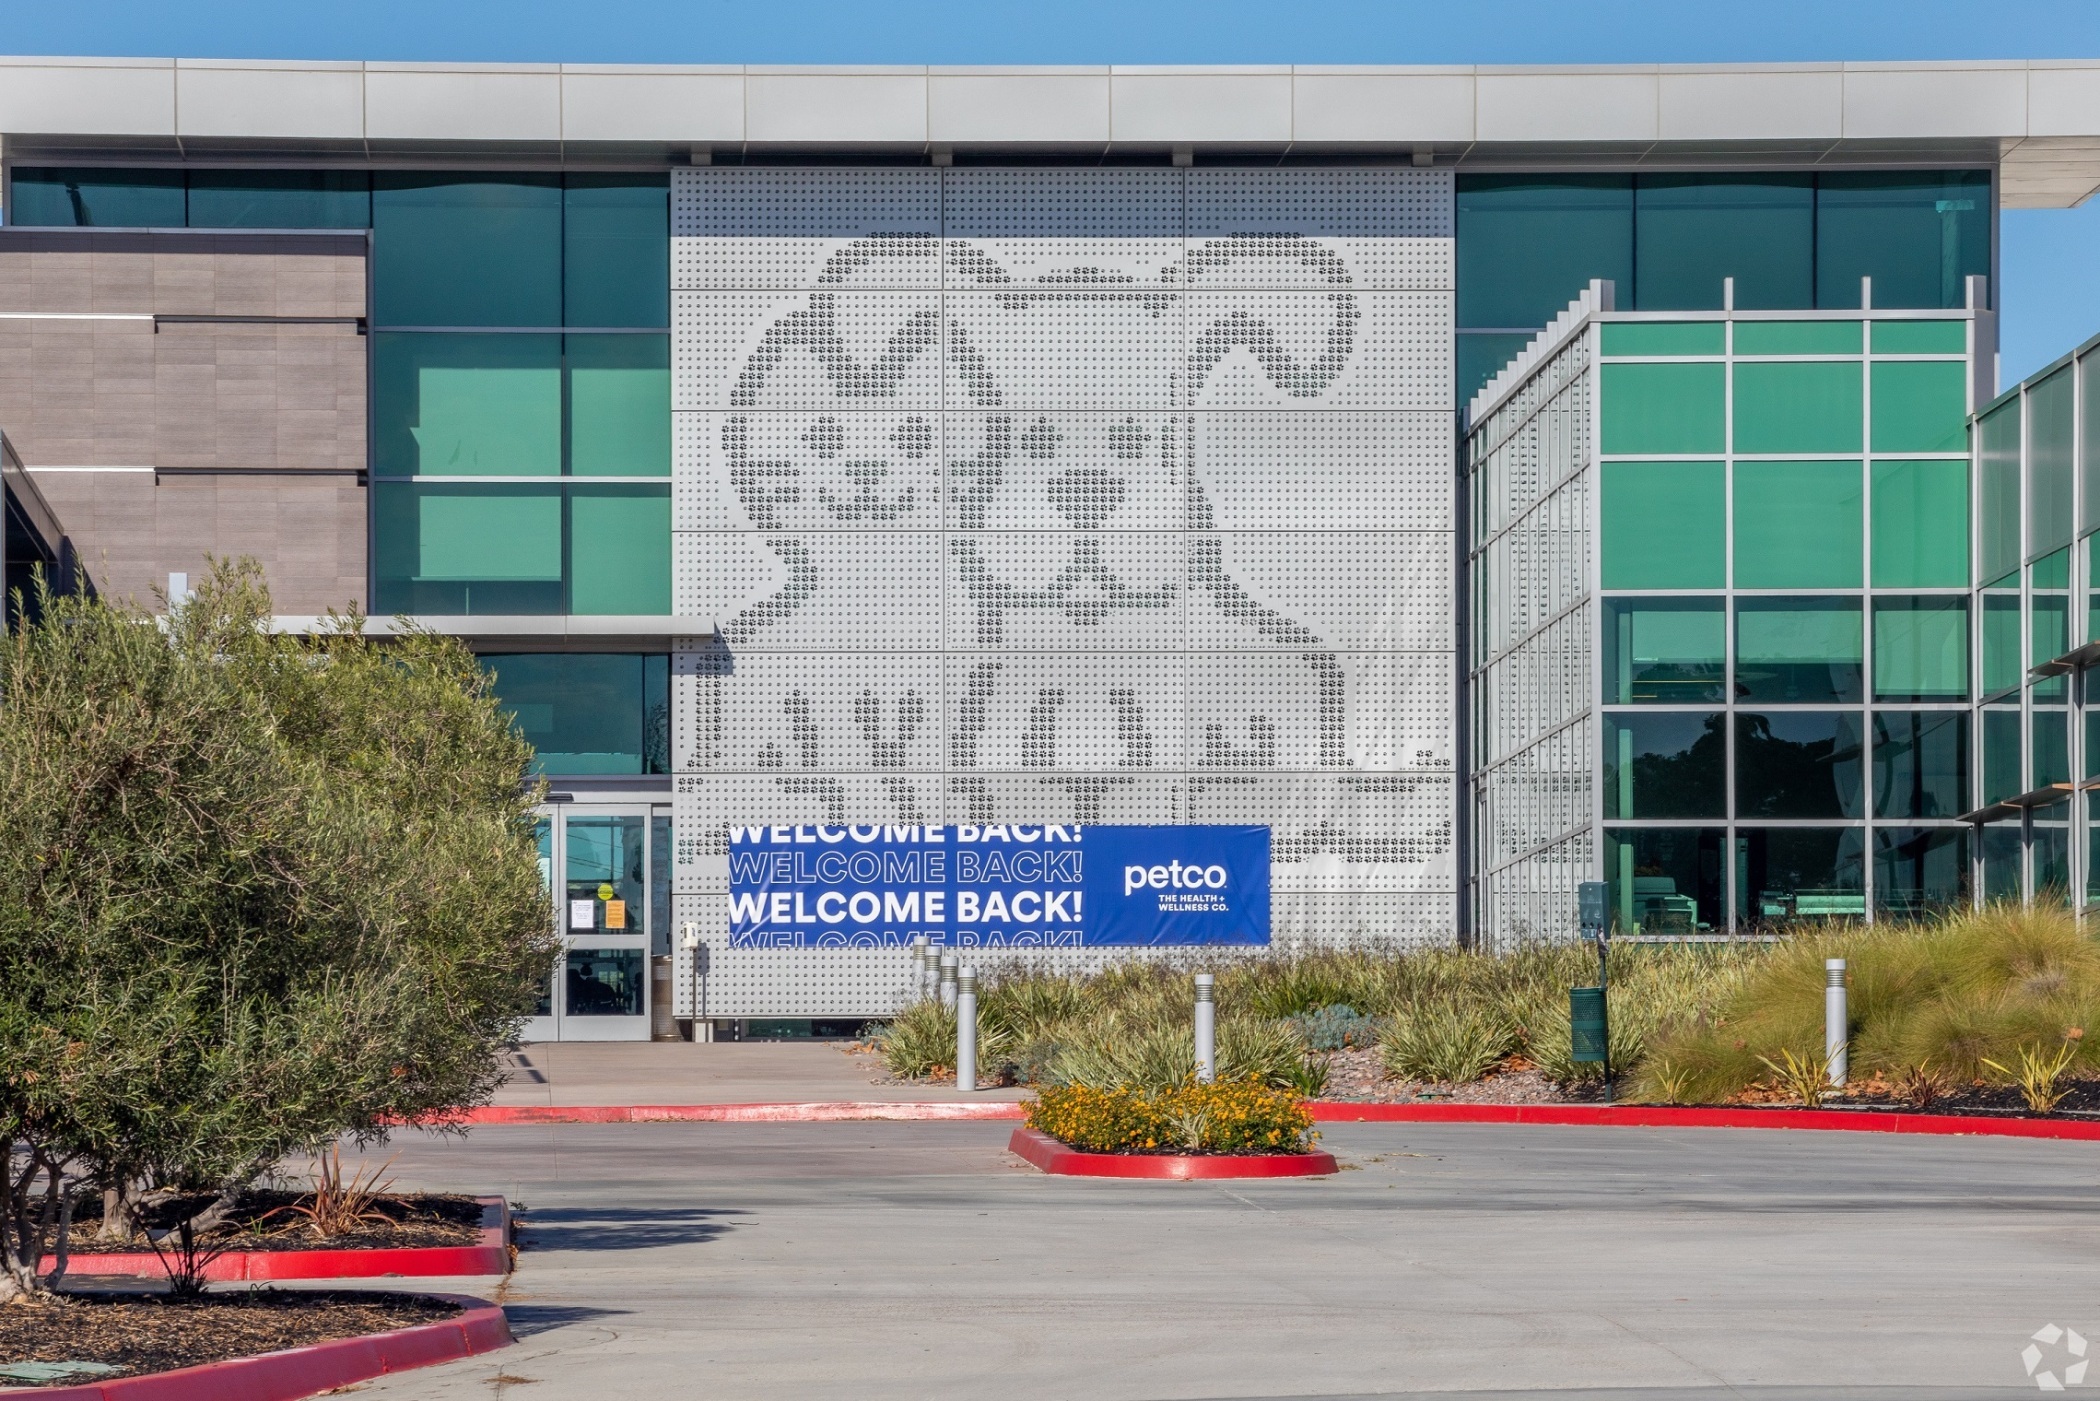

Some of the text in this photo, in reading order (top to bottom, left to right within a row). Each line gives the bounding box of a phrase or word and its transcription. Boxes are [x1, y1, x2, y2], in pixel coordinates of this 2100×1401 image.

[729, 826, 1083, 843] WELCOME BACK!
[729, 850, 1083, 884] WELCOME BACK!
[1125, 859, 1227, 896] petco
[729, 891, 1083, 923] WELCOME BACK!
[1158, 894, 1177, 902] THE
[1180, 894, 1217, 902] HEALTH
[1158, 903, 1229, 911] WELLNESS CO.
